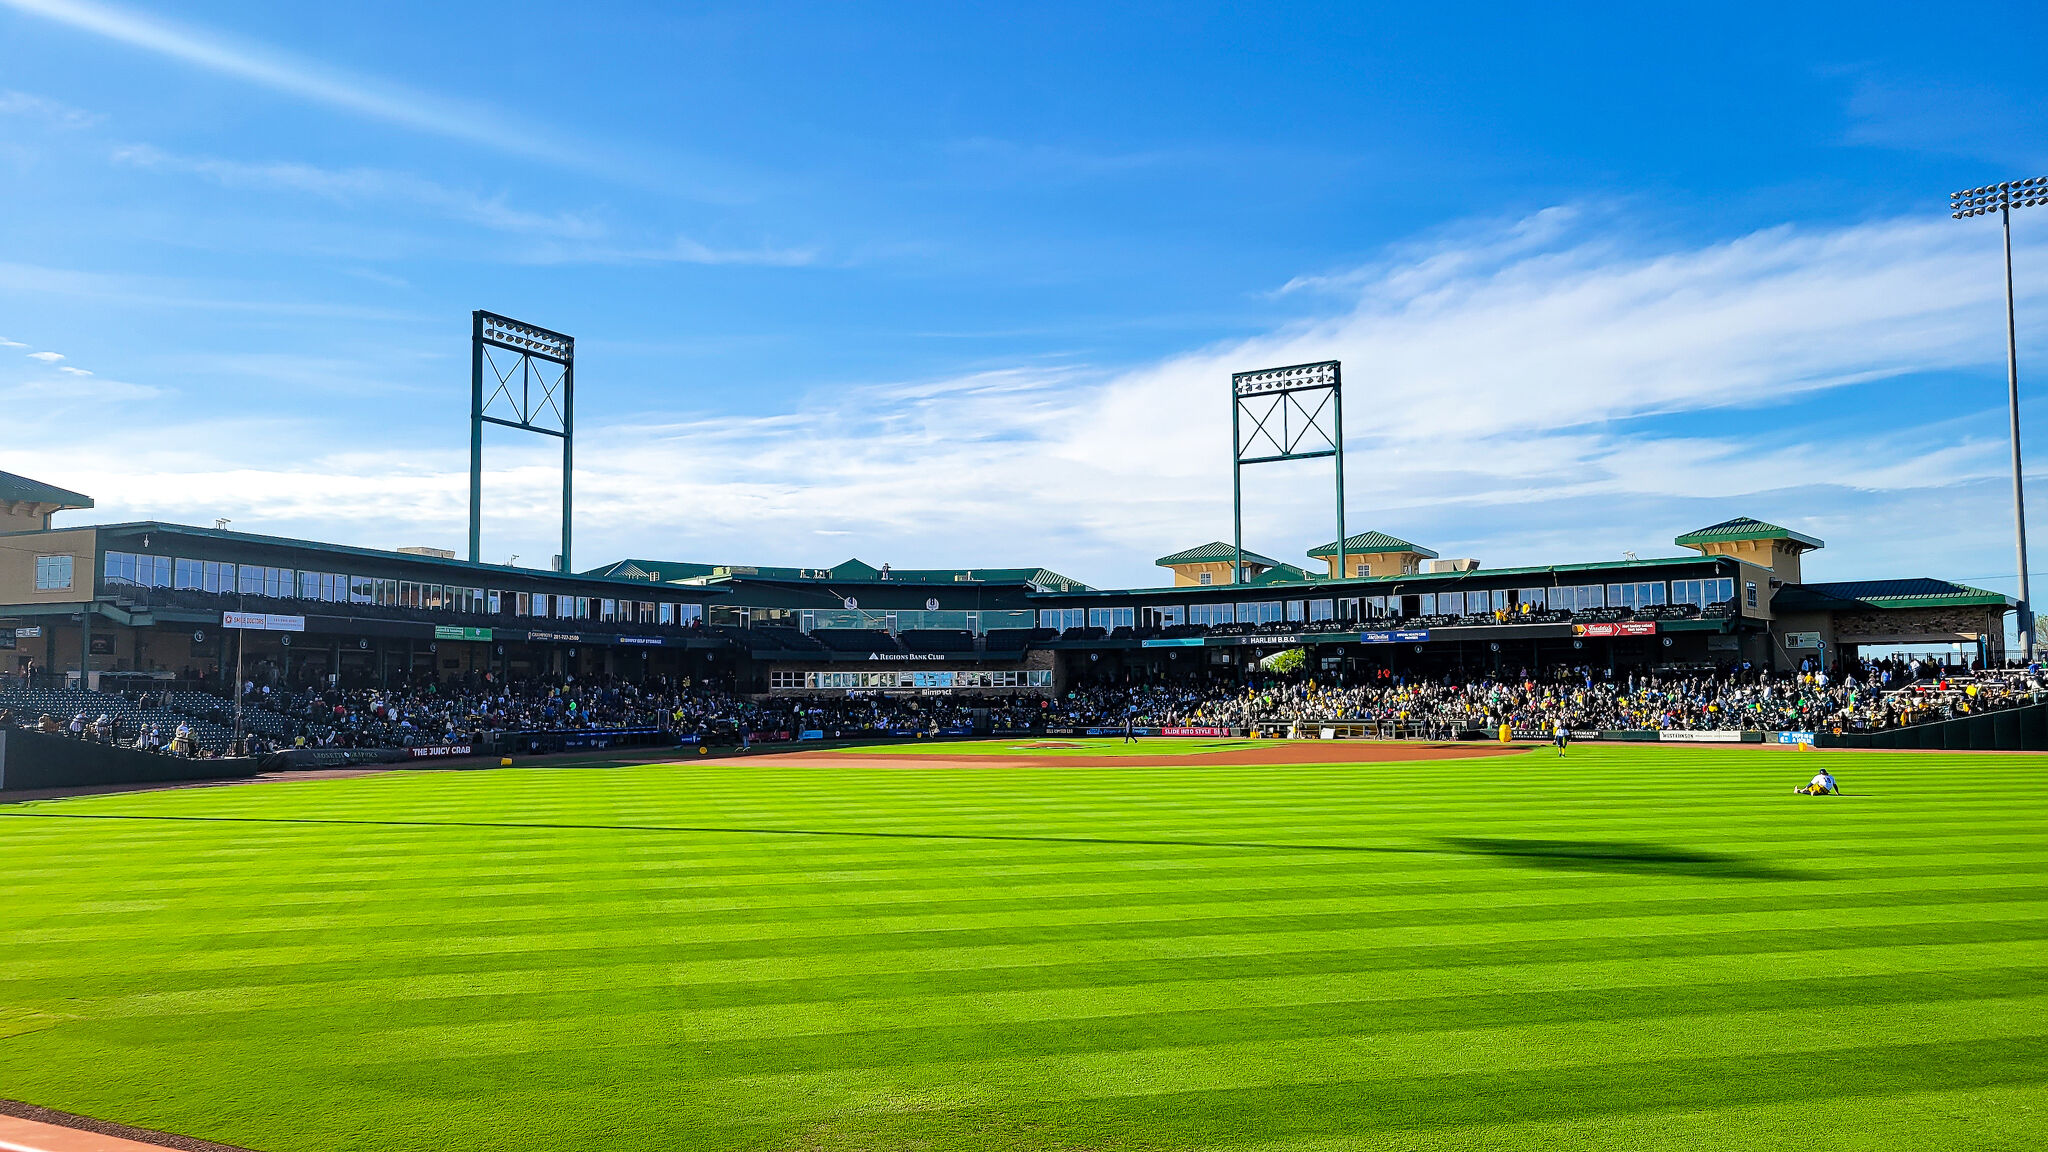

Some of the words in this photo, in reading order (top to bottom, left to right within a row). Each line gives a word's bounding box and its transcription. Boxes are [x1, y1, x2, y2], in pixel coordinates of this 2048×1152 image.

[413, 748, 428, 757] THE
[429, 746, 450, 755] JUICY
[452, 745, 471, 754] CRAB
